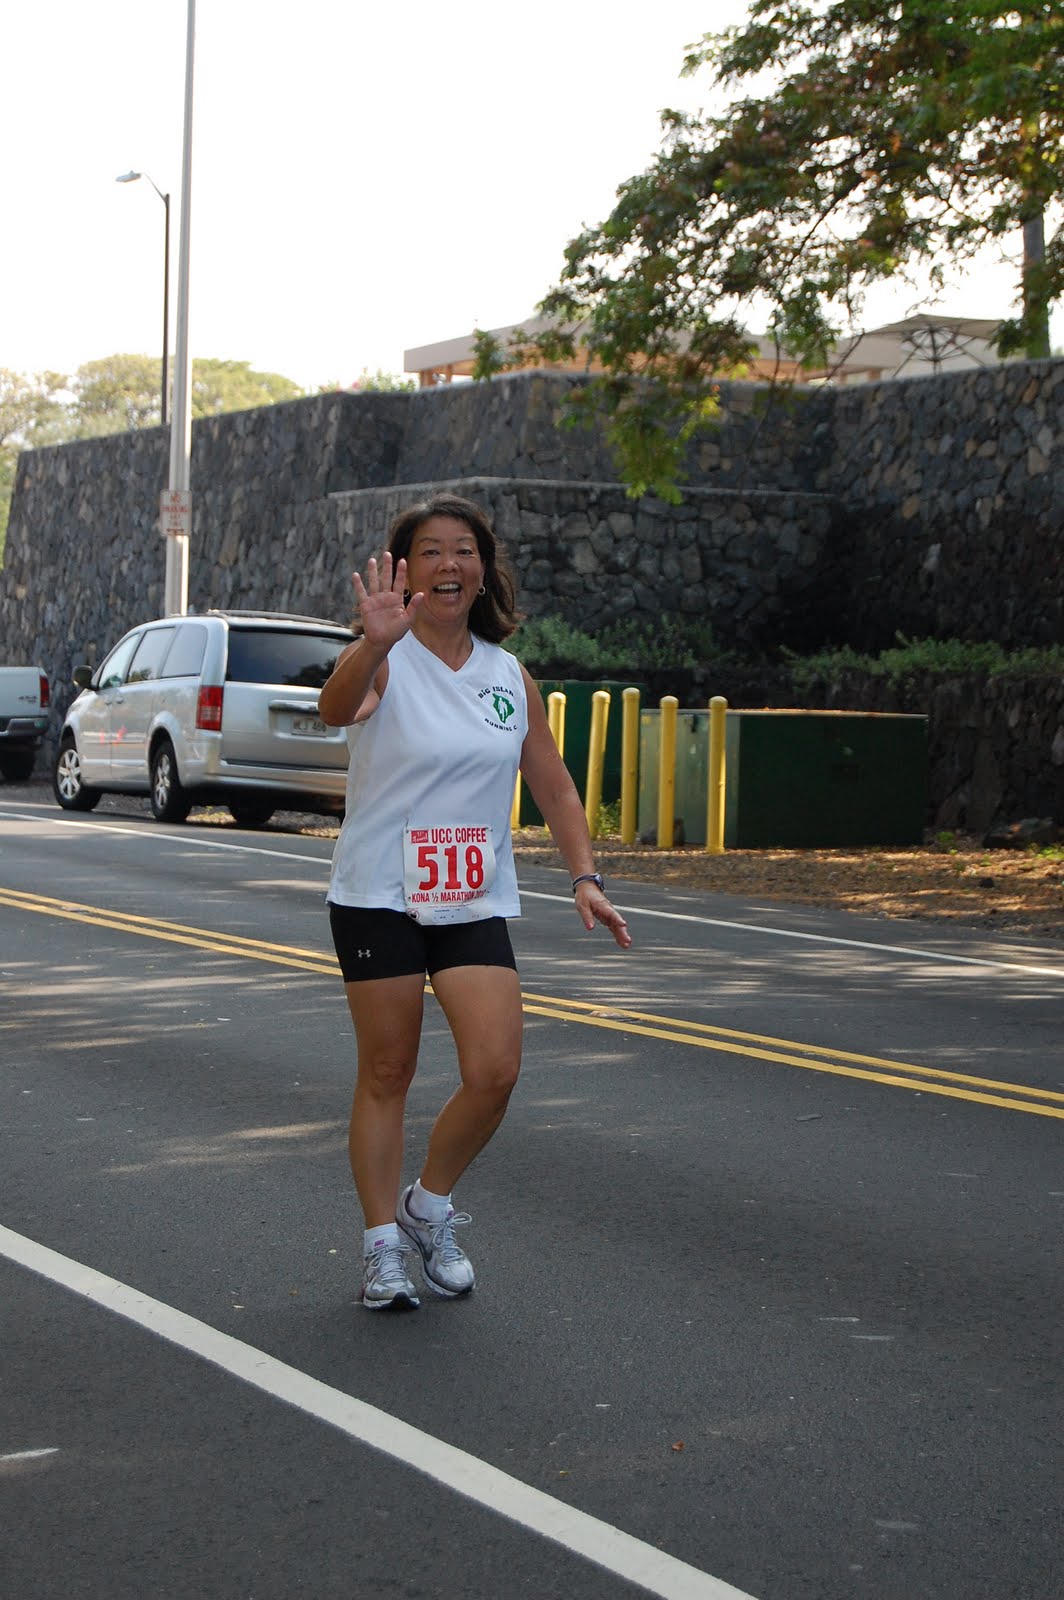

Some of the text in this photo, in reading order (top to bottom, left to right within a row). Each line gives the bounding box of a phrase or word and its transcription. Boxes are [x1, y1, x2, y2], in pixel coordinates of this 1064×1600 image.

[477, 686, 515, 699] BIG ISLAN
[484, 718, 512, 732] RUNNING
[431, 828, 453, 844] UCC
[455, 827, 487, 843] COFFEE
[417, 845, 484, 890] 518
[411, 893, 430, 903] KONA
[440, 890, 475, 902] MARATHON
